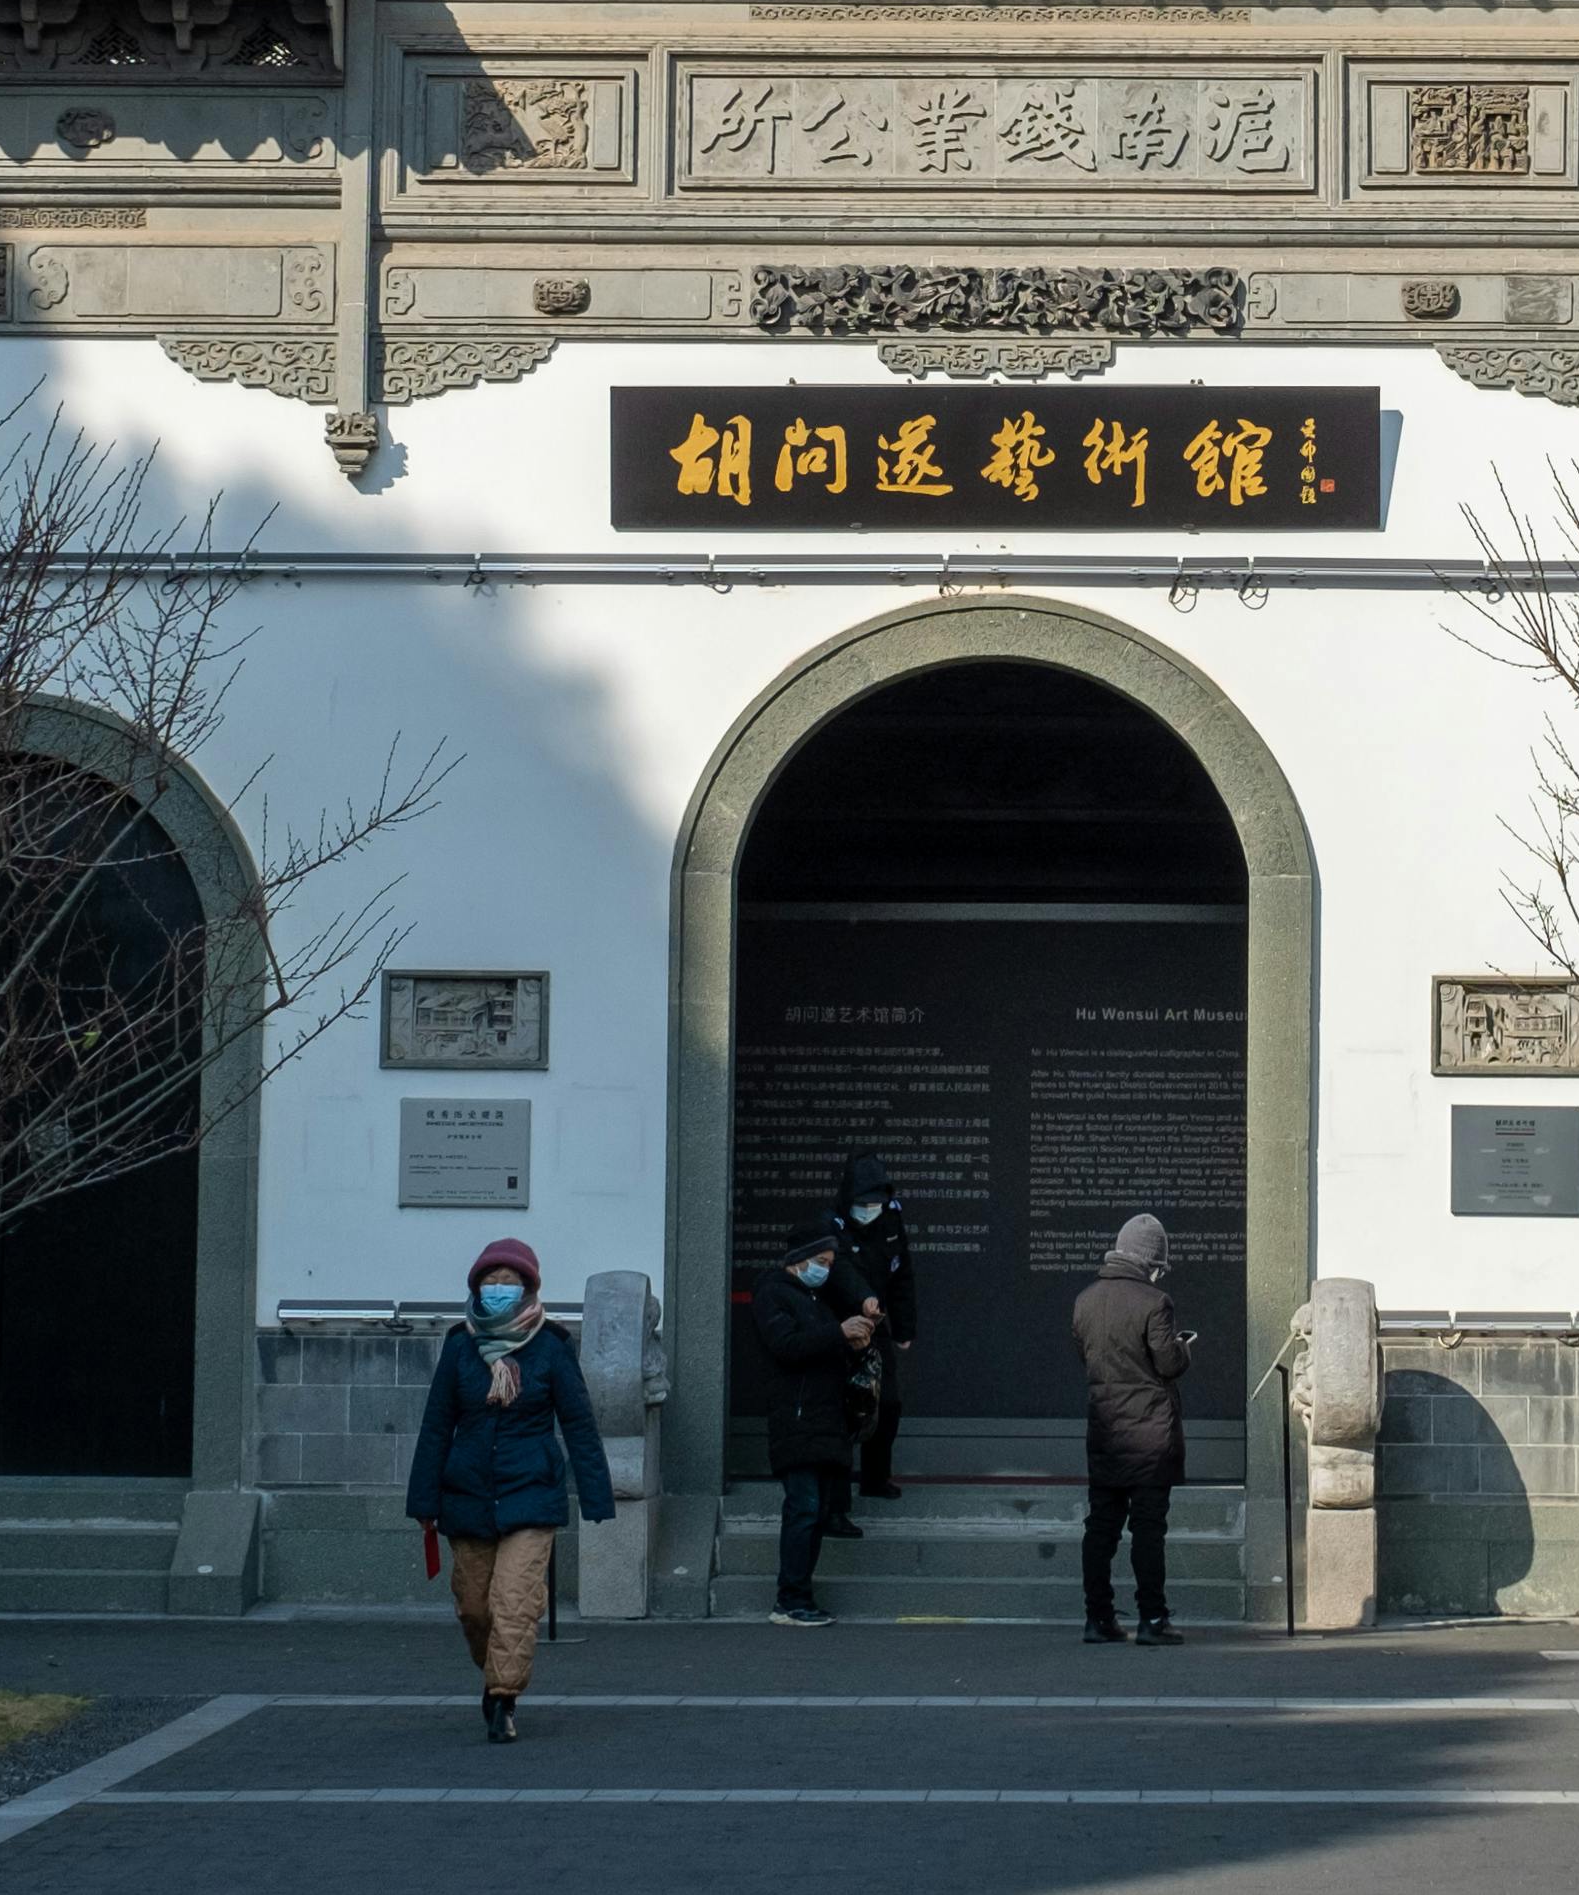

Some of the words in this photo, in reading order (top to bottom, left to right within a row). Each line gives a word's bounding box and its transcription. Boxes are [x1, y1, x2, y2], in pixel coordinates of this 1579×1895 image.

[785, 1006, 925, 1024] 胡问遂艺术馆简介
[1076, 1008, 1096, 1021] Hu
[1102, 1008, 1159, 1021] Wensui
[1164, 1008, 1188, 1021] Art
